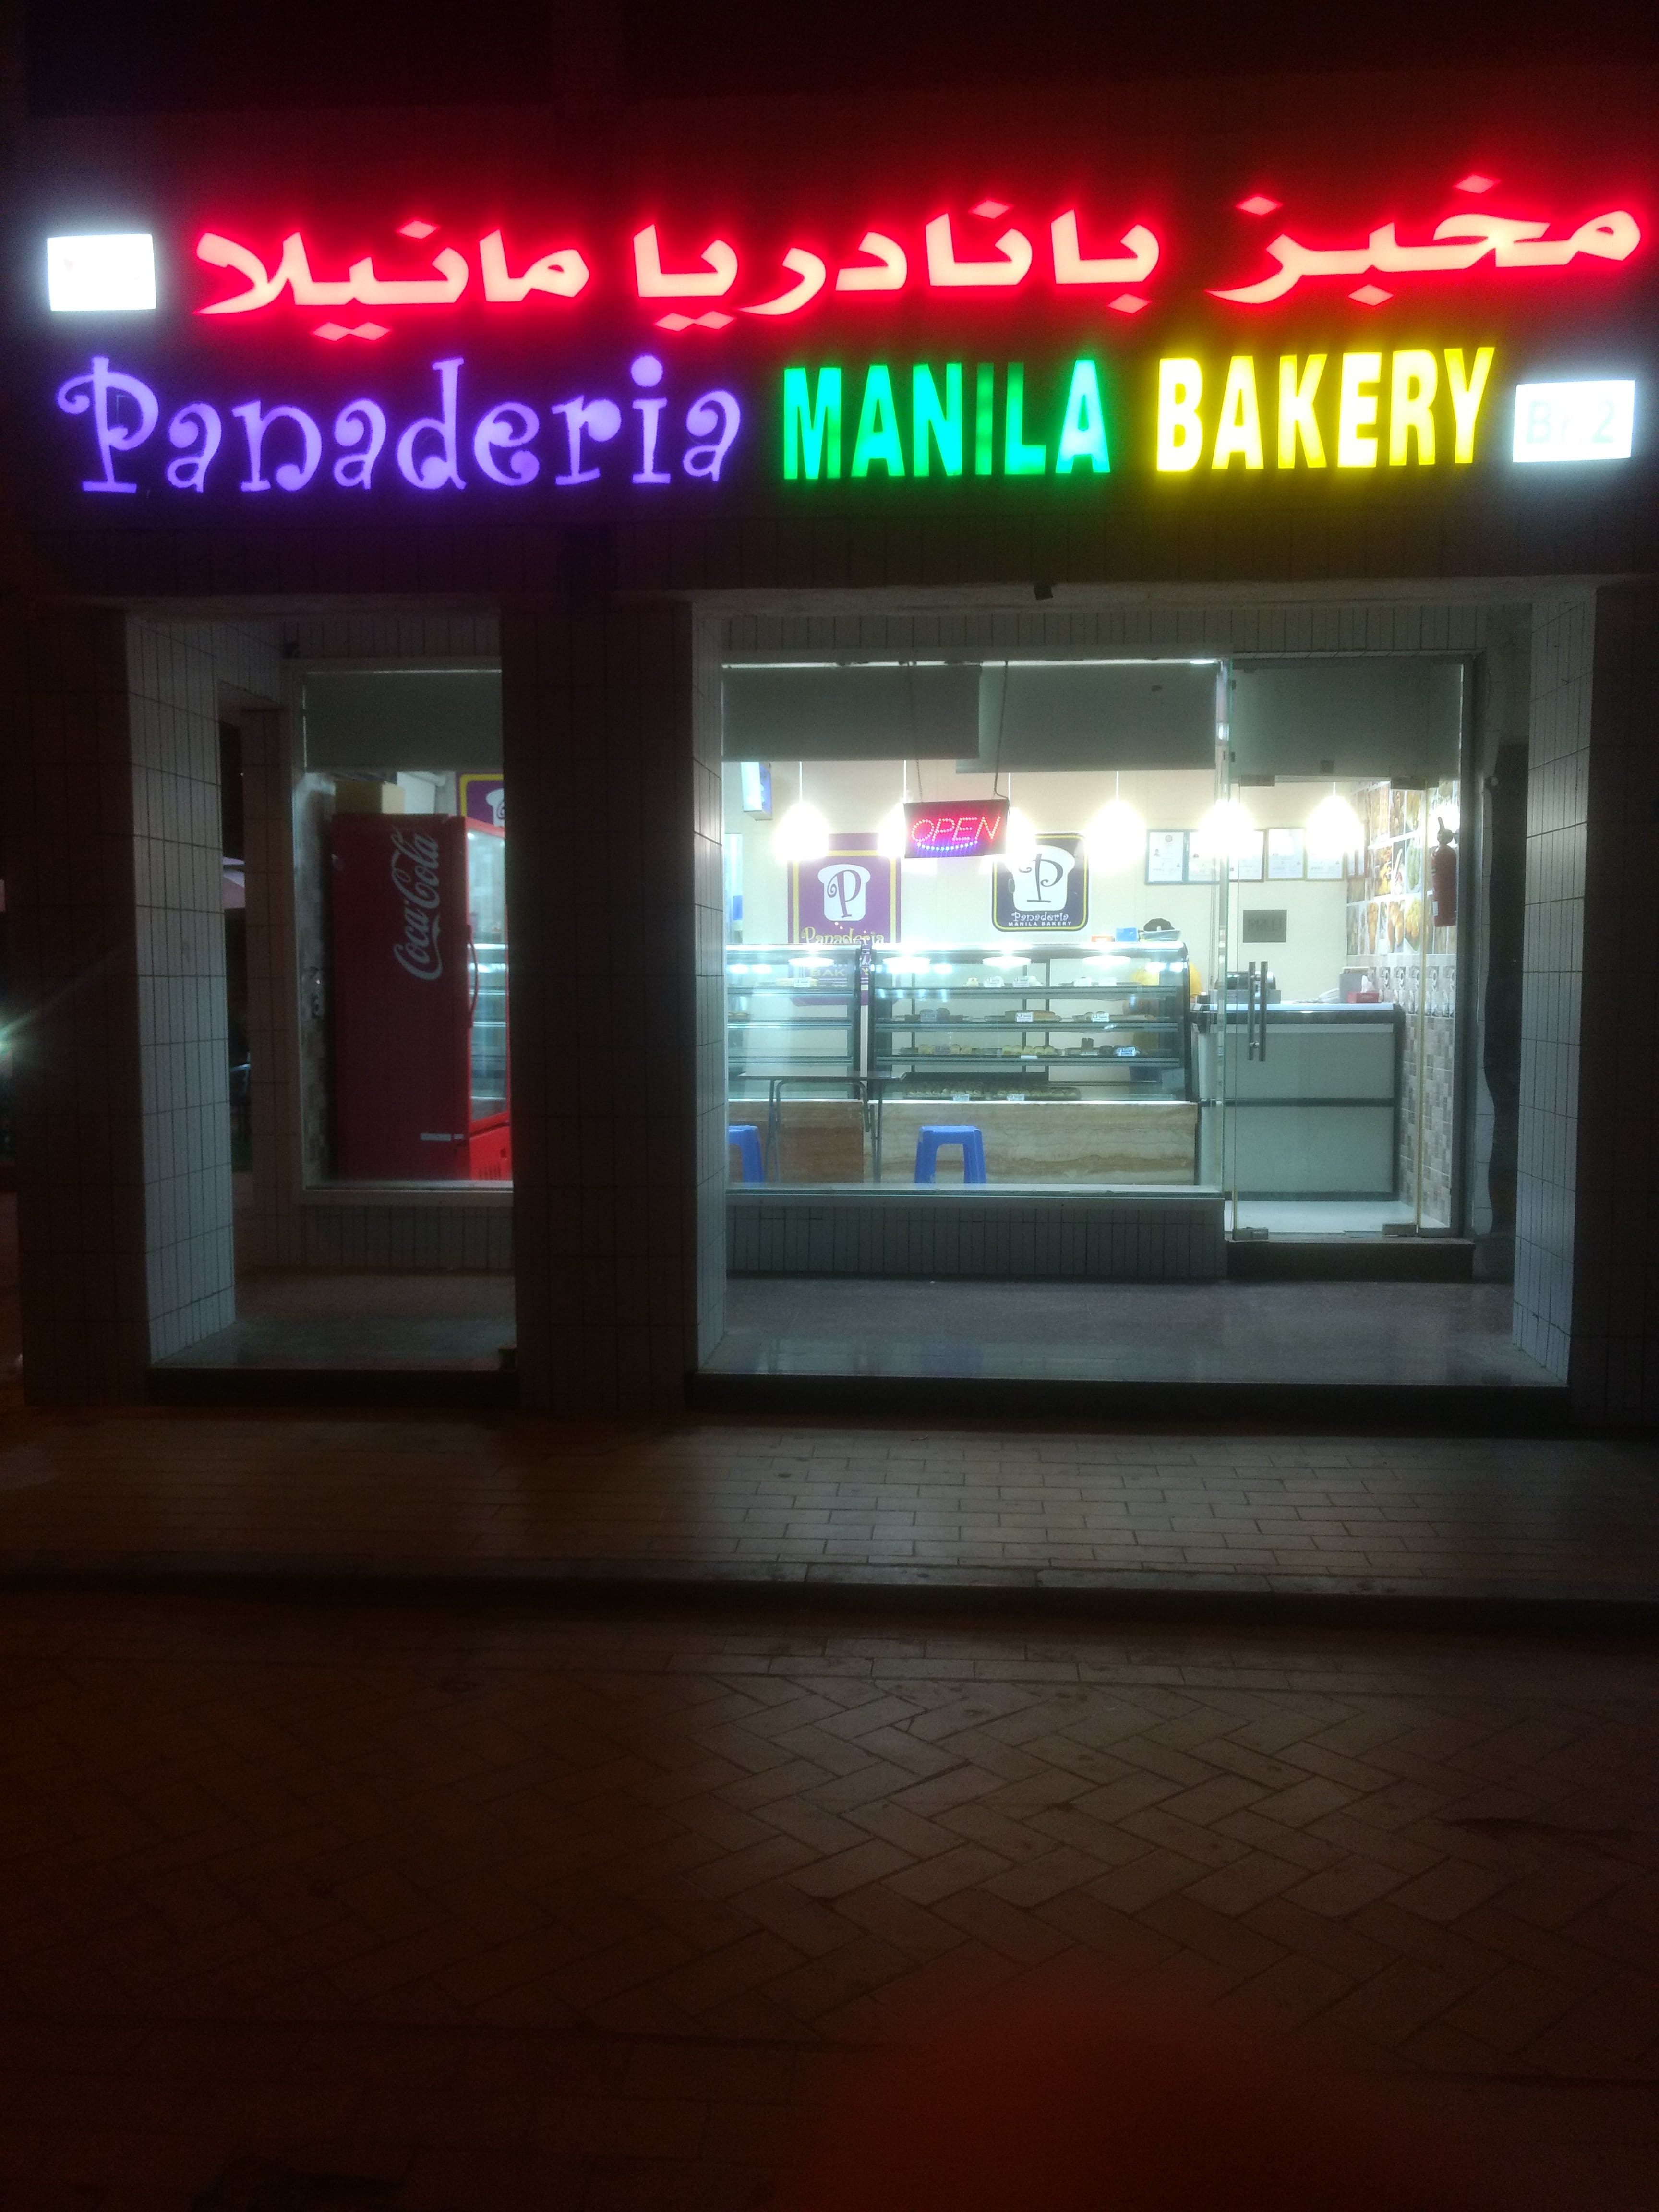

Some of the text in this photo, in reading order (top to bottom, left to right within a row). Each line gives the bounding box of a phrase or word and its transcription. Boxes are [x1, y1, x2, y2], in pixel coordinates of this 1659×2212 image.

[192, 173, 1642, 341] مخبز بانادريا مانيلا
[56, 347, 1495, 493] Panaderia MANILA BAKERY
[911, 816, 1001, 842] OPEN
[1011, 912, 1069, 922] Panaderia
